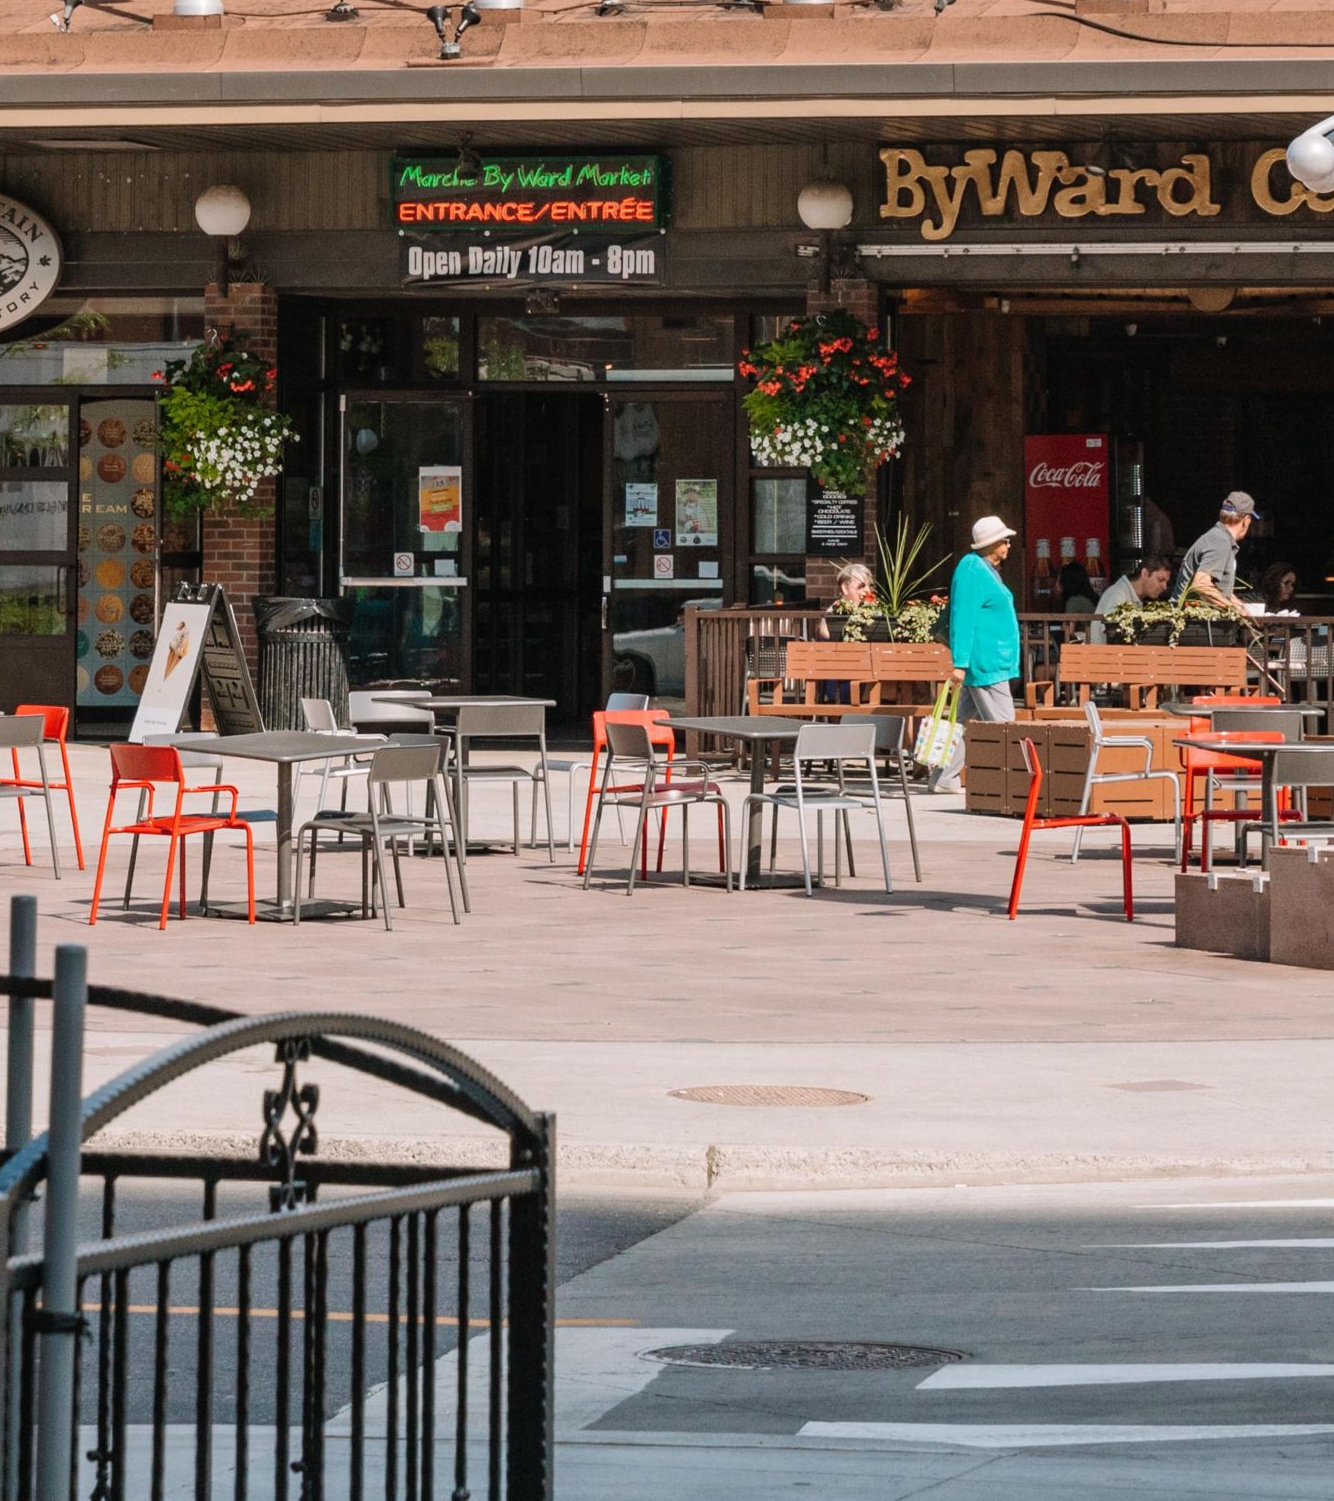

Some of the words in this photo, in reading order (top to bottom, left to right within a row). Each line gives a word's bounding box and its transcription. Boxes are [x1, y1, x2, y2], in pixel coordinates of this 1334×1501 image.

[483, 164, 515, 193] By
[517, 164, 574, 188] Ward
[576, 164, 654, 187] Market
[878, 147, 1221, 241] ByWard
[399, 197, 655, 222] ENTRANCE/ENTRÉE
[408, 246, 462, 279] Open
[468, 246, 522, 279] Daily
[528, 246, 585, 274] 10am
[607, 245, 655, 279] 8pm
[1029, 461, 1105, 488] Coca-Cola
